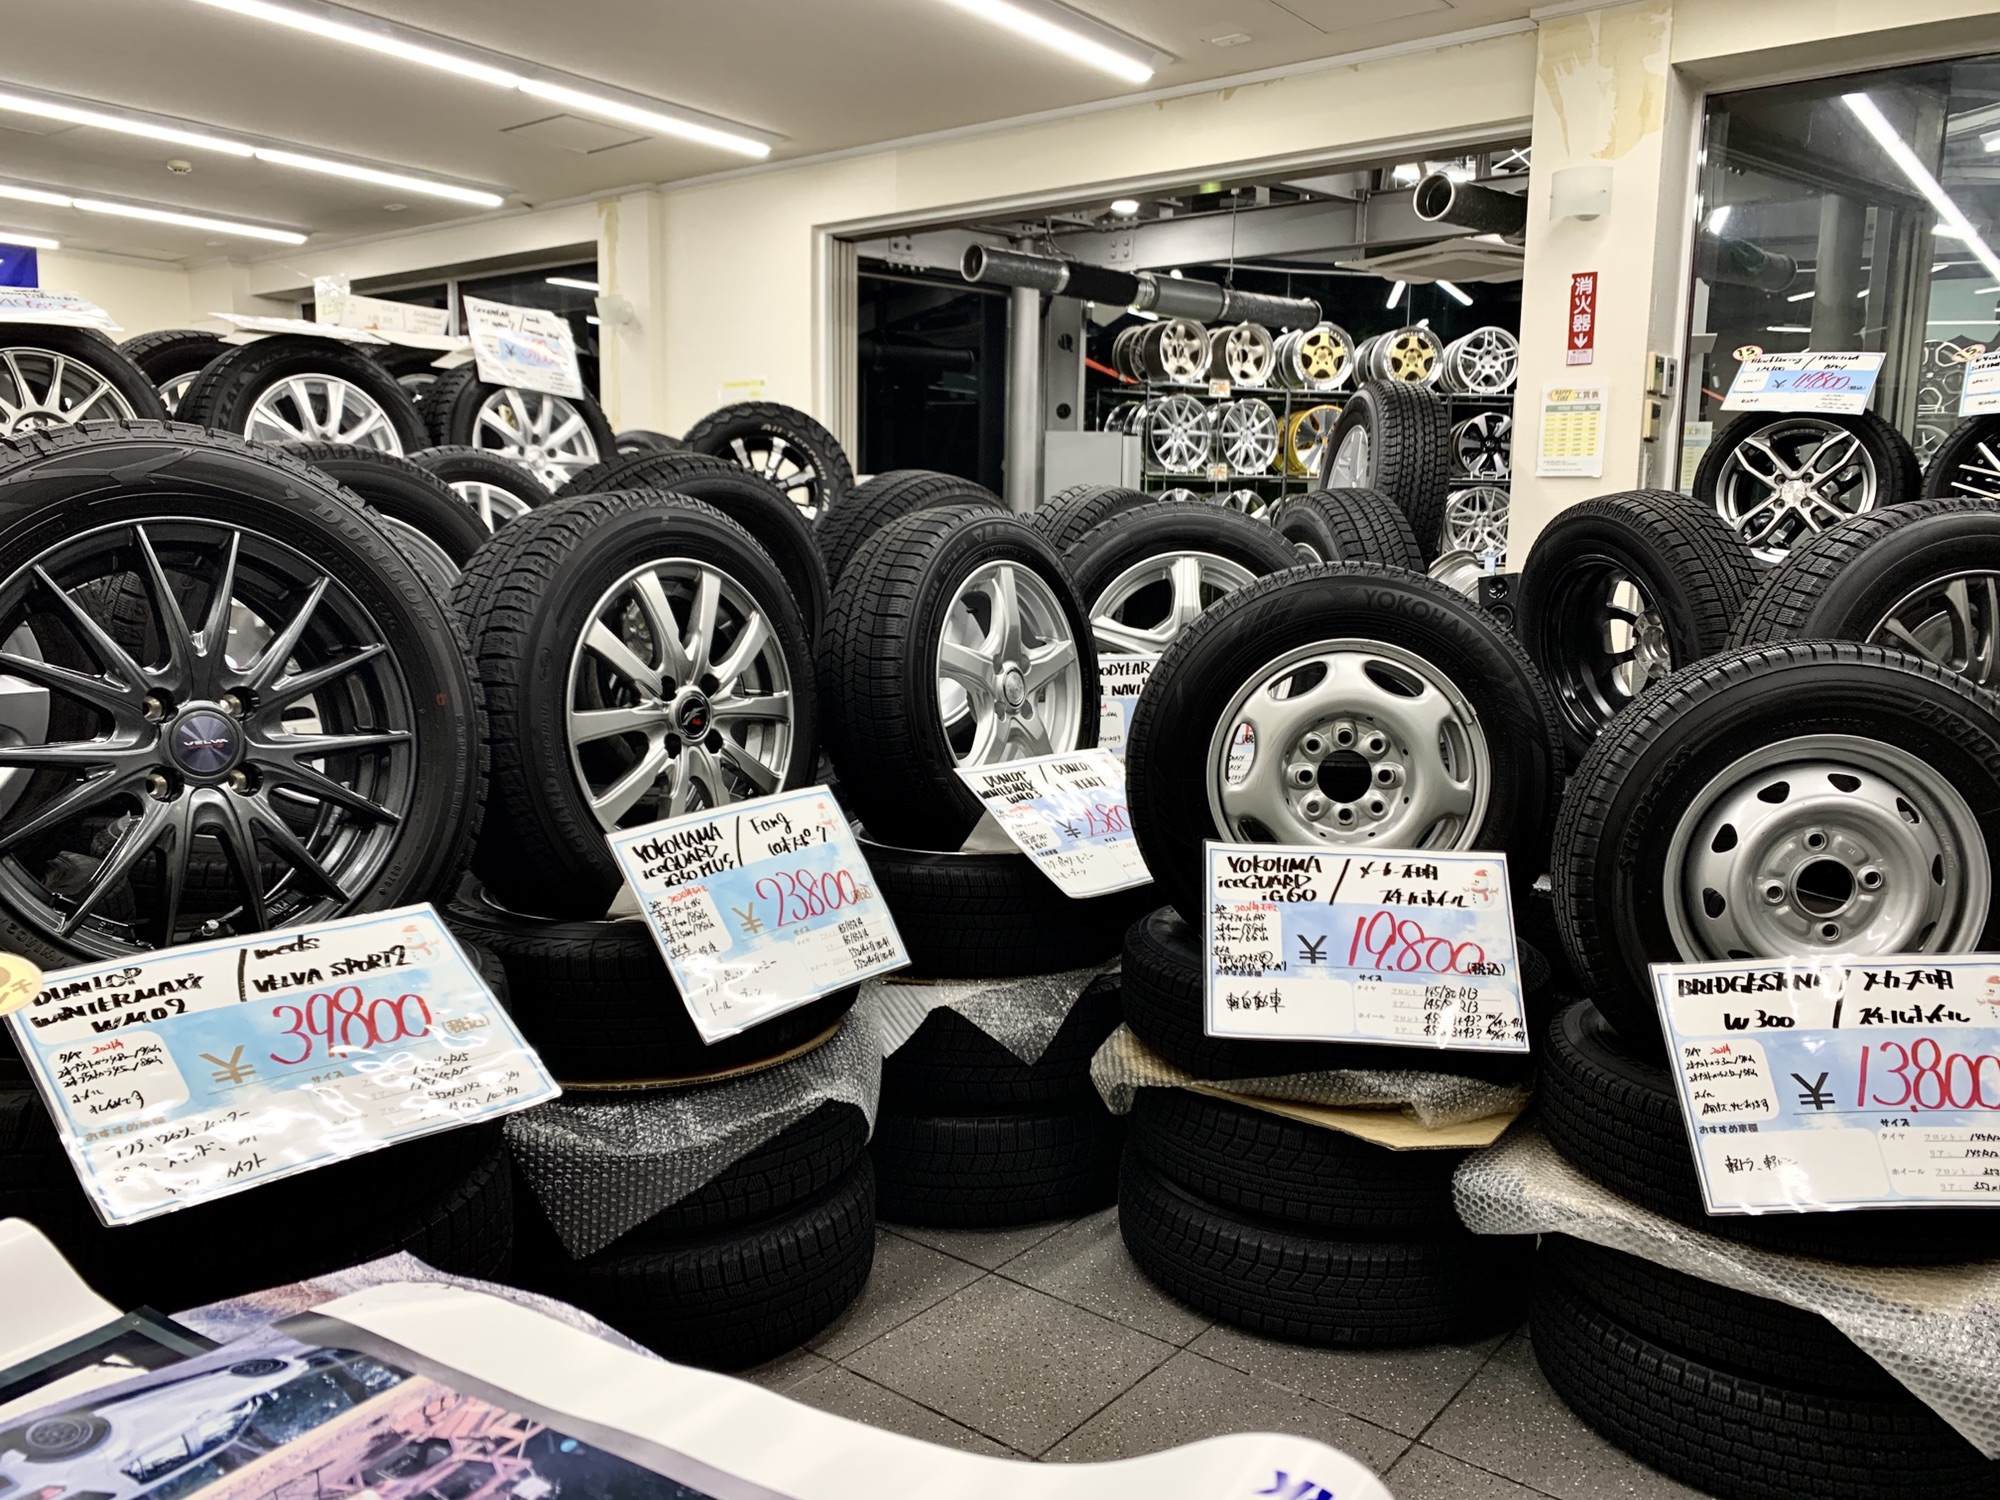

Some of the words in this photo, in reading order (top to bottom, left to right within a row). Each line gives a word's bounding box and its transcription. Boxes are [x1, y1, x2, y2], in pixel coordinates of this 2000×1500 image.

[1573, 276, 1593, 332] 消火器
[749, 812, 793, 835] Fang
[731, 901, 764, 934] ¥
[1297, 934, 1328, 964] ¥
[32, 967, 143, 1008] DUNLOP
[90, 997, 190, 1034] WM02
[197, 1043, 257, 1086] ¥
[1790, 1072, 1836, 1111] ¥
[1880, 1118, 1910, 1128] サイズ
